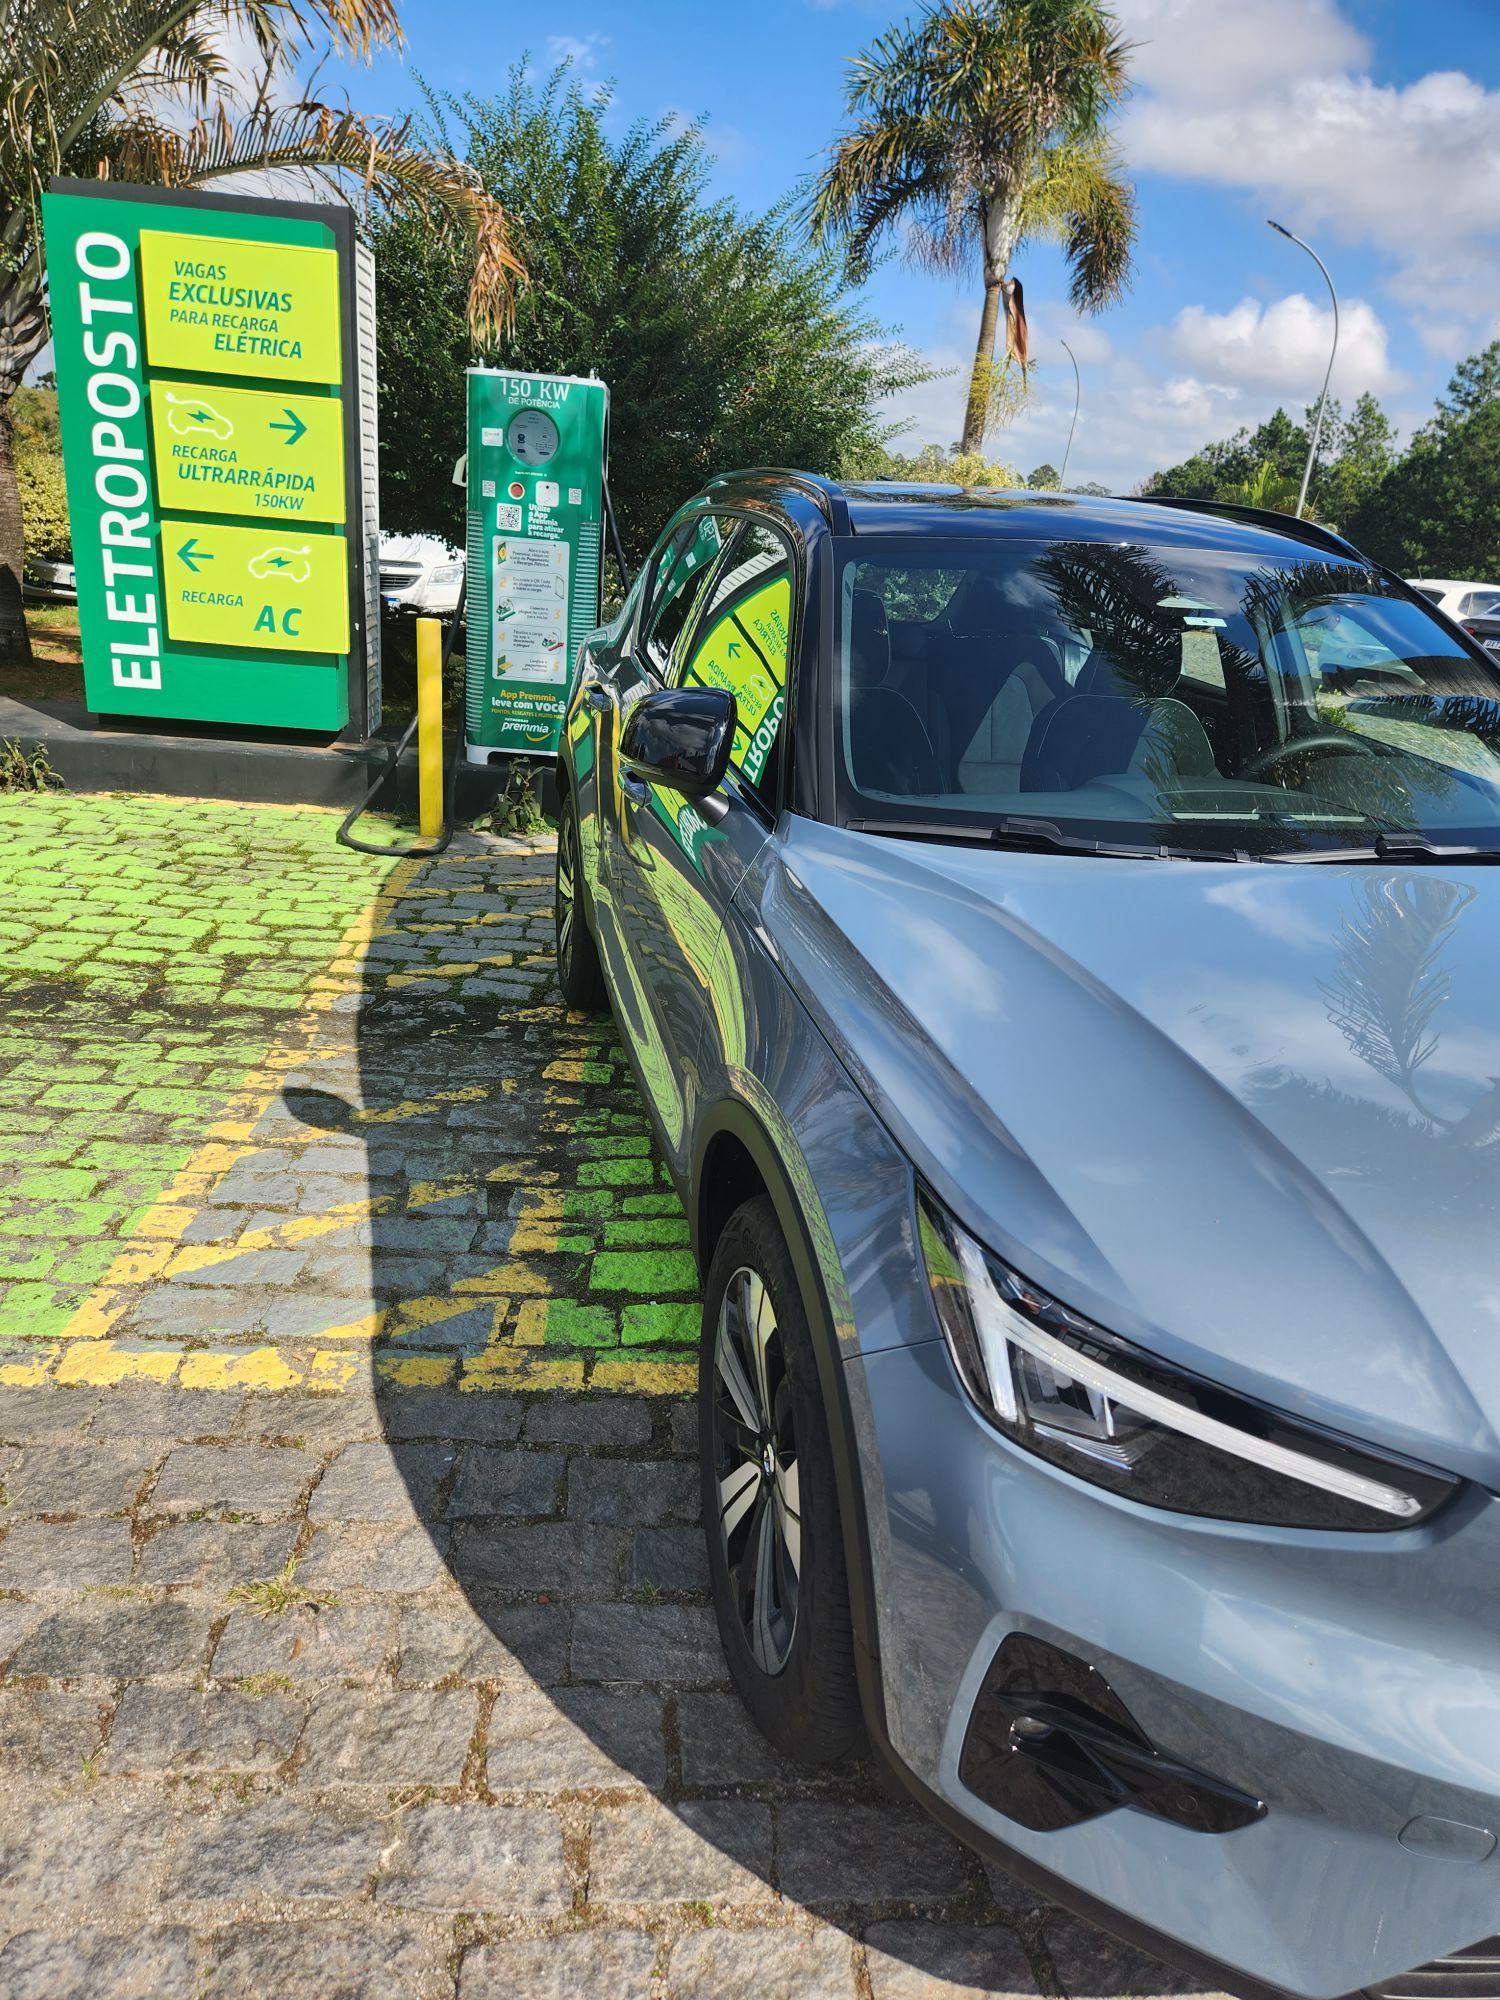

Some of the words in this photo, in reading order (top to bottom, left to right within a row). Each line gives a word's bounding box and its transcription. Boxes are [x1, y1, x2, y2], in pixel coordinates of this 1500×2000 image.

[174, 260, 227, 280] VAGAS
[168, 281, 292, 313] EXCLUSIVAS
[170, 309, 208, 325] PARA
[212, 313, 279, 333] RECARGA
[214, 330, 302, 359] ELÉTRICA
[500, 378, 531, 398] 150
[540, 381, 570, 401] KW
[508, 397, 519, 405] DE
[521, 398, 561, 409] POTÊNCIA
[75, 231, 162, 691] ELETROPOSTO
[172, 444, 238, 463] RECARGA
[178, 463, 315, 492] ULTRARRÁPIDA
[255, 493, 304, 511] 150KW
[182, 590, 244, 607] RECARGA
[253, 605, 303, 637] AC
[491, 697, 512, 708] leve
[513, 701, 533, 710] com
[535, 700, 567, 714] você
[501, 689, 518, 700] App
[519, 691, 556, 702] Premmia
[501, 721, 549, 734] premmia
